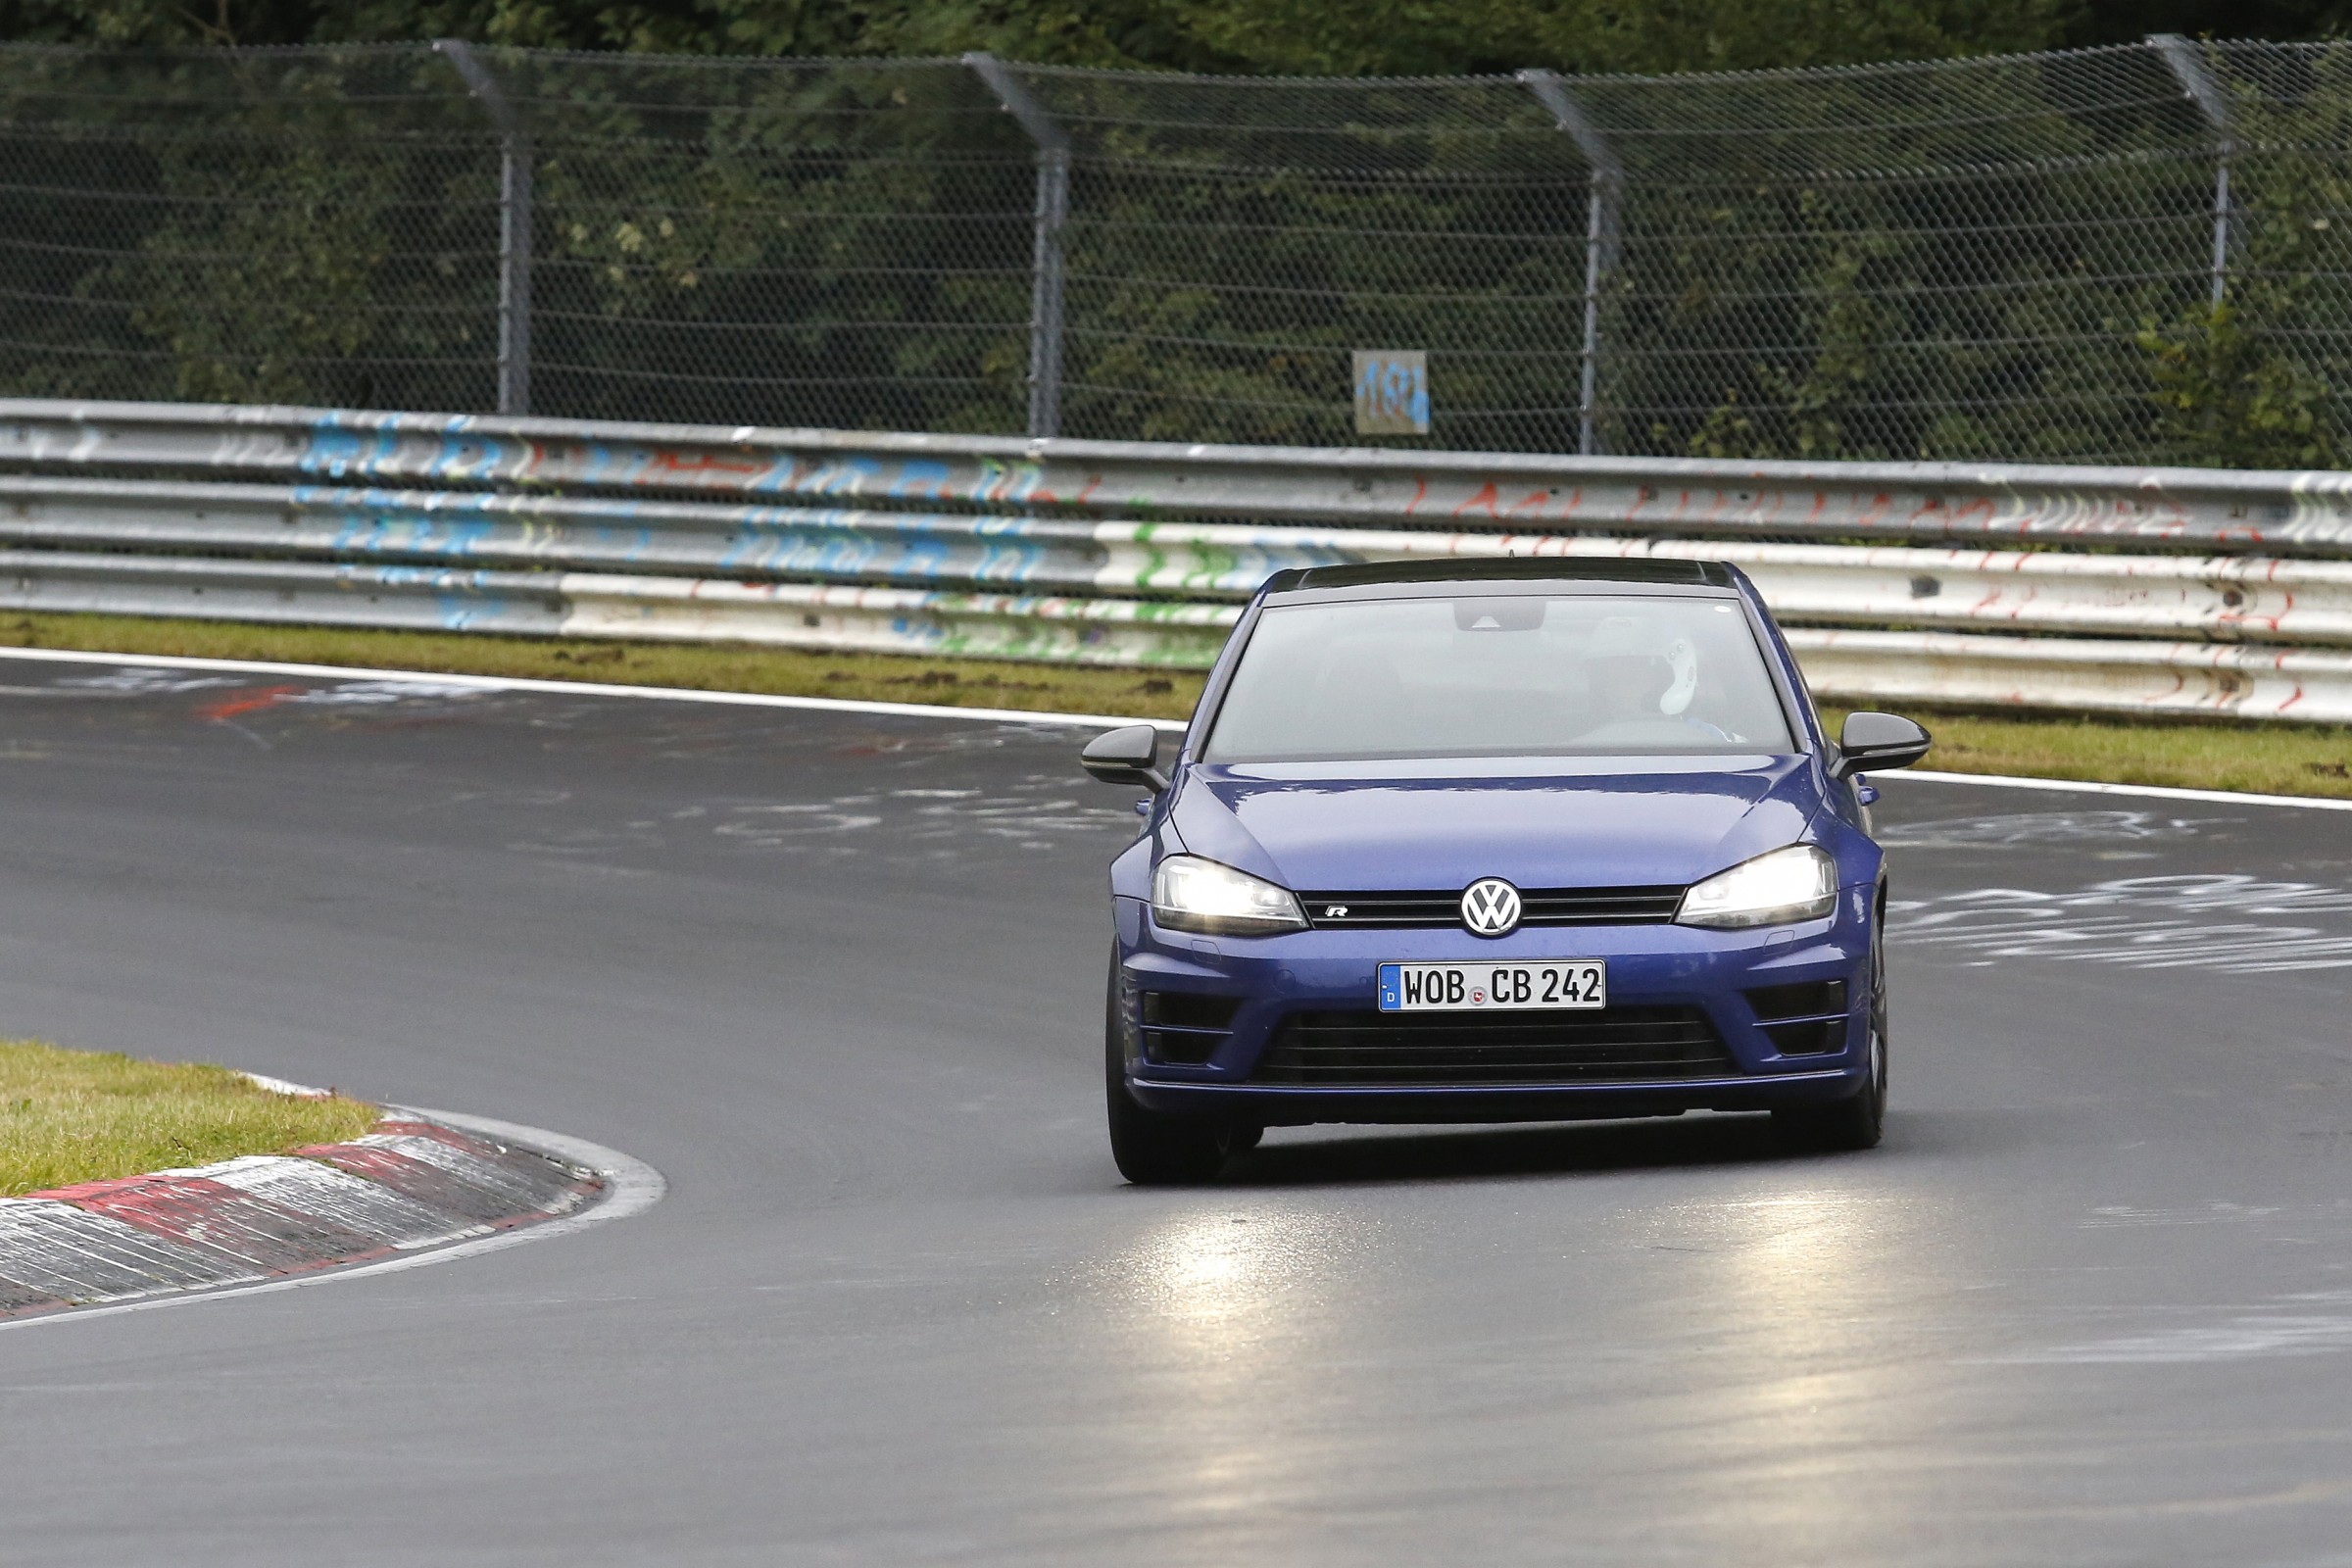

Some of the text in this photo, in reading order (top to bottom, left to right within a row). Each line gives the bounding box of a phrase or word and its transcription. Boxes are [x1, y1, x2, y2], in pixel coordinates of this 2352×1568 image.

[1325, 905, 1348, 917] R
[1462, 880, 1521, 934] VW
[1387, 992, 1396, 1003] D
[1403, 967, 1600, 1004] WOB CB 242
